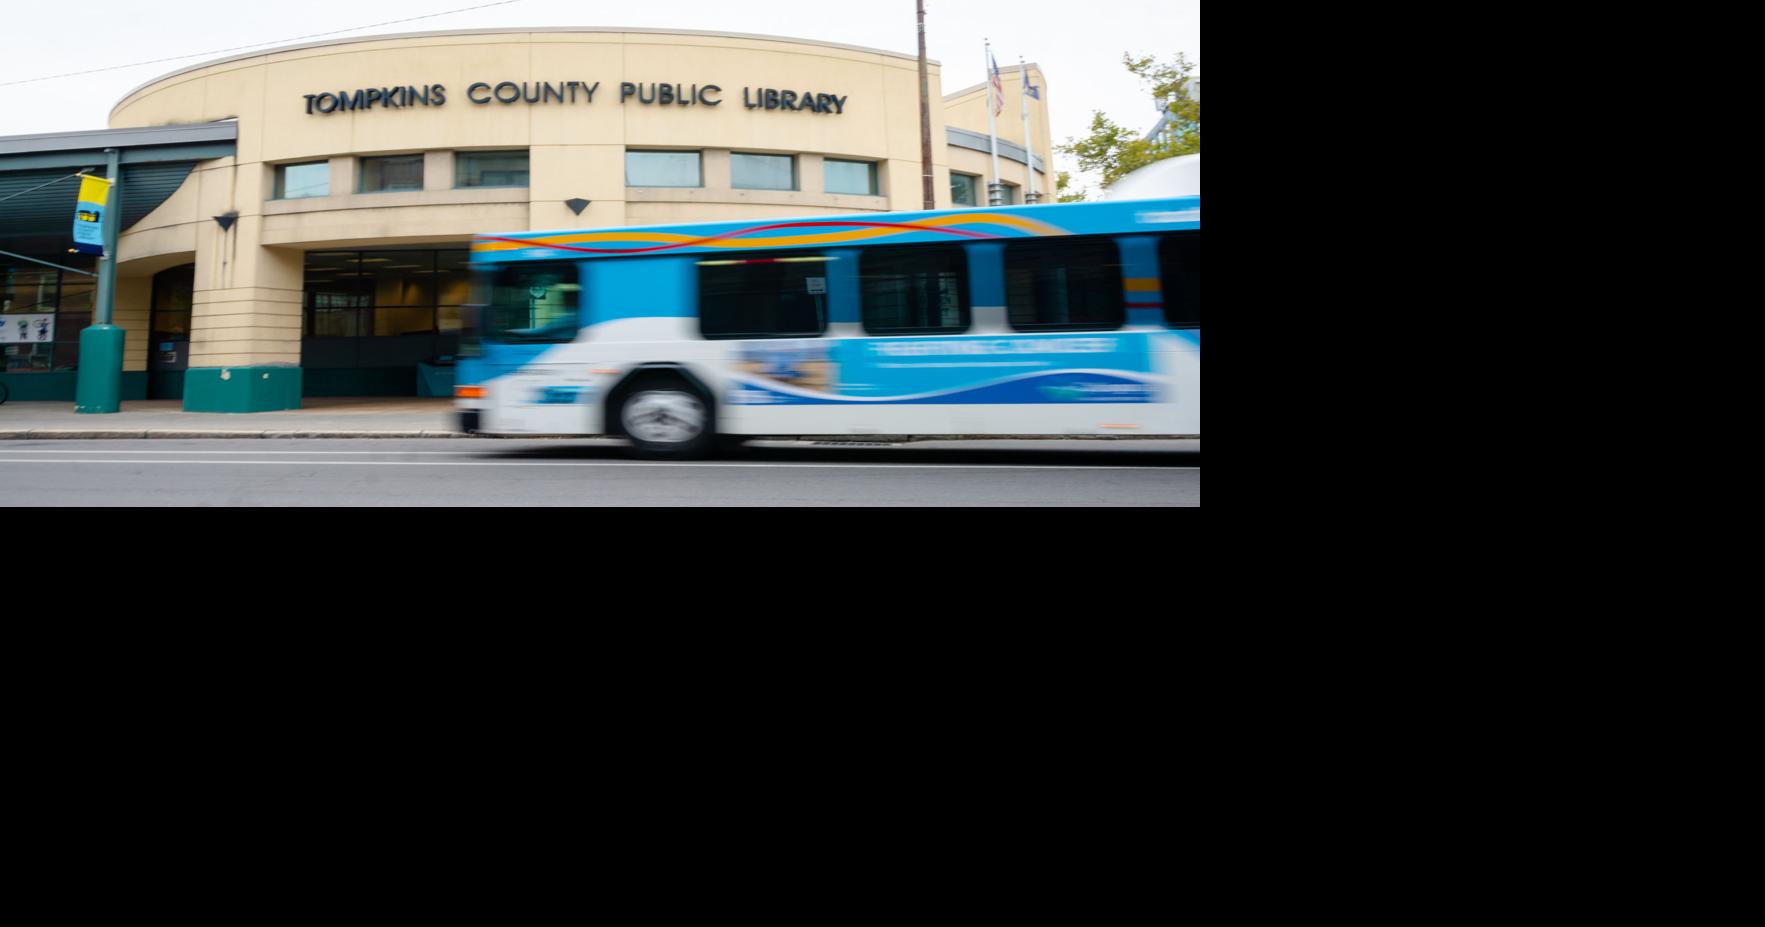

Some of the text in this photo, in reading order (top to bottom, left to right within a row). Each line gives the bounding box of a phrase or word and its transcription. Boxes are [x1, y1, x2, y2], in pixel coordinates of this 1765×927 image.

[303, 81, 847, 114] TOMPKINS COUNTY PUBLIC LIBRARY
